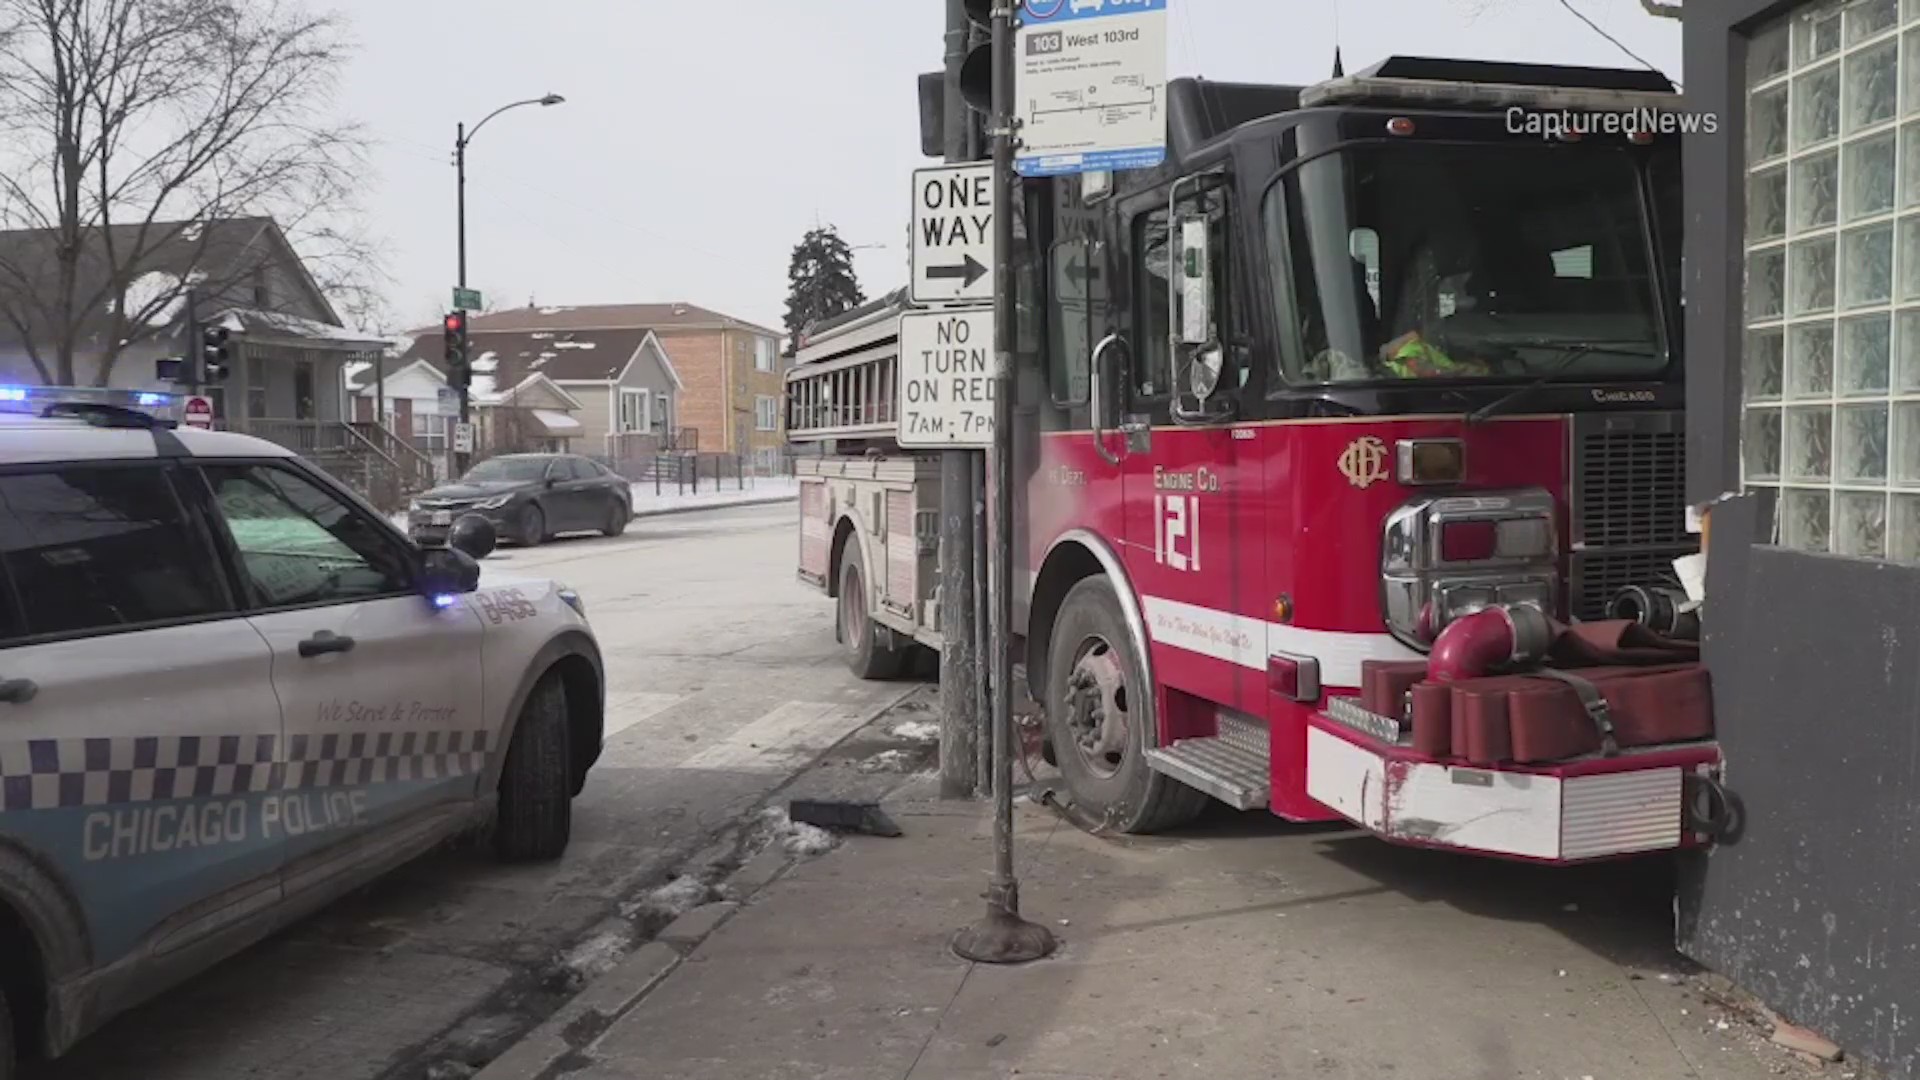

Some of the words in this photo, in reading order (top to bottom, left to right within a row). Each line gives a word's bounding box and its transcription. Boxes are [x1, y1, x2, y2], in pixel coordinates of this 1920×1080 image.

[1033, 35, 1059, 52] 103
[1066, 33, 1099, 47] West
[1103, 28, 1139, 43] 103rd
[924, 176, 991, 209] ONE
[922, 214, 992, 246] WAY
[937, 320, 970, 344] NO
[922, 348, 985, 374] TURN
[907, 379, 938, 402] ON
[953, 377, 995, 402] RED
[1154, 495, 1200, 571] 121
[318, 698, 343, 721] We
[346, 700, 387, 722] Serve
[83, 802, 246, 861] CHICAGO
[260, 790, 370, 838] POLICE
